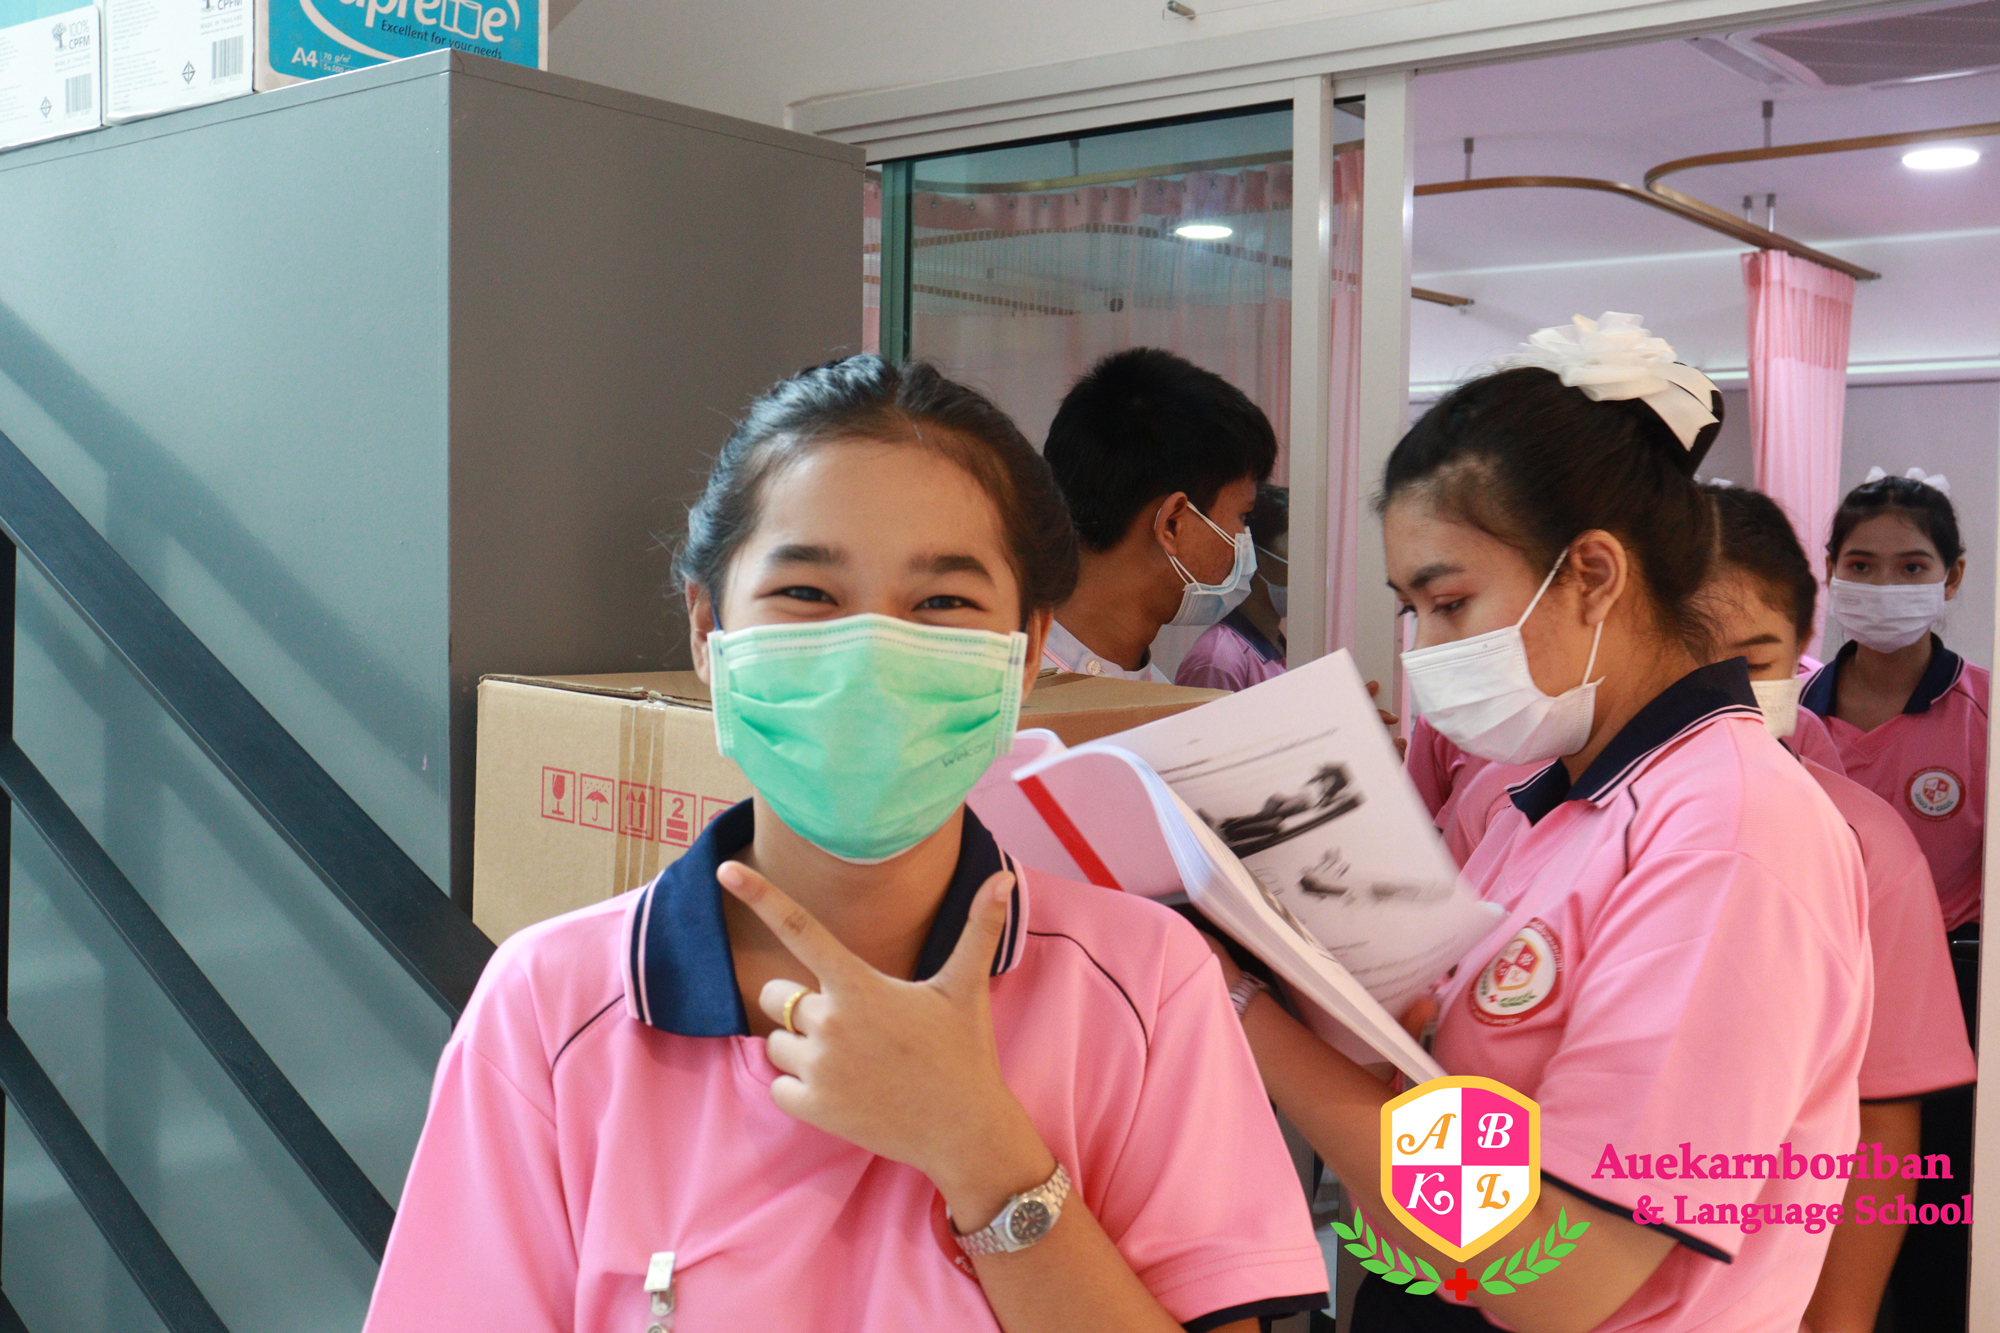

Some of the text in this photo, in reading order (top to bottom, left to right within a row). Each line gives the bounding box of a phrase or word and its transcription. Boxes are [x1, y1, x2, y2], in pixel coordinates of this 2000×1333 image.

[381, 19, 502, 60] Excellent for your needs
[291, 47, 318, 68] A4
[323, 52, 332, 61] 70
[671, 797, 685, 819] 2
